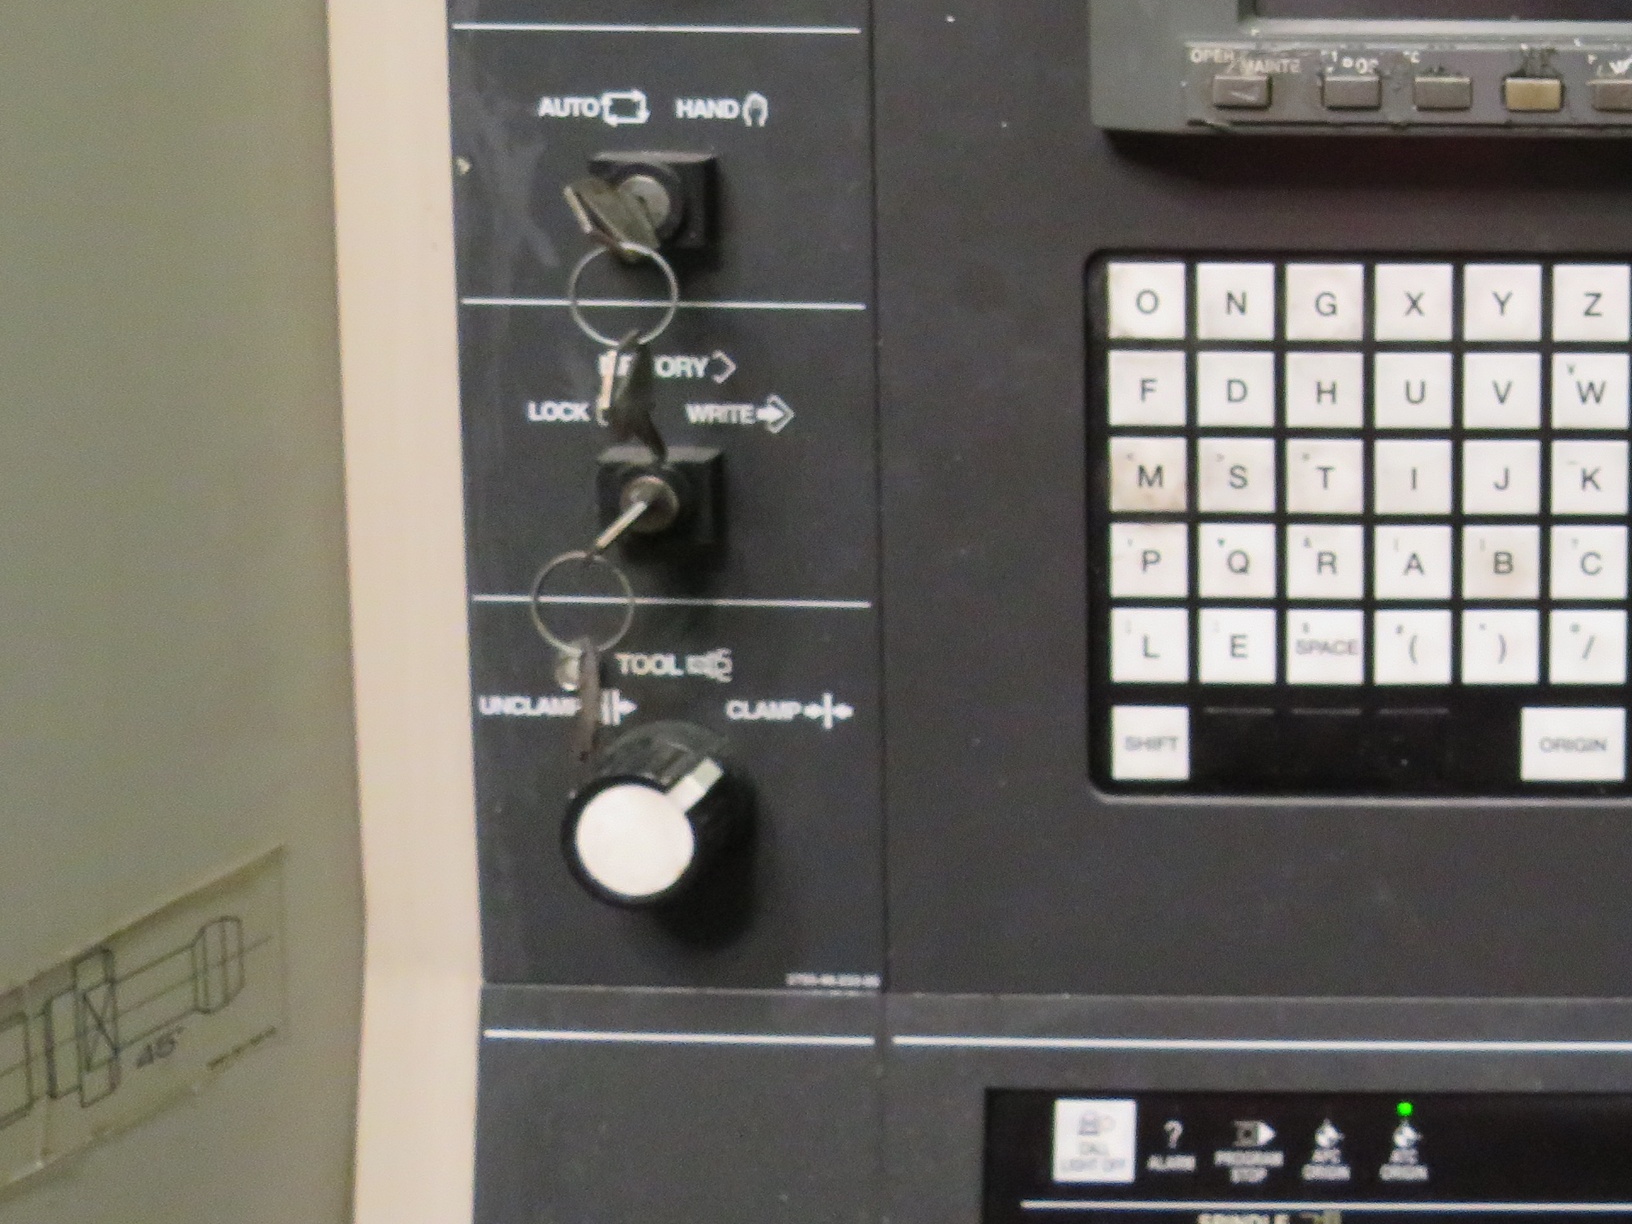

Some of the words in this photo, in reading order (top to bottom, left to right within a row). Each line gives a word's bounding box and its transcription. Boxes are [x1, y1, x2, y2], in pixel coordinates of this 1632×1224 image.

[539, 99, 599, 116] AUTO
[676, 99, 740, 118] HAND
[1136, 289, 1160, 314] O
[1226, 291, 1247, 315] N
[1315, 292, 1338, 317] G
[1405, 292, 1424, 315] X
[1493, 292, 1512, 316] Y
[1584, 292, 1602, 317] Z
[1140, 378, 1157, 402] F
[1227, 379, 1248, 403] D
[1316, 381, 1337, 403] H
[1405, 381, 1426, 405] U
[1493, 381, 1512, 405] V
[1577, 381, 1606, 404] W
[528, 401, 589, 421] LOCK
[687, 403, 755, 424] WRITE
[1138, 465, 1163, 488] M
[1229, 464, 1248, 489] S
[1316, 466, 1335, 489] T
[1494, 467, 1510, 491] J
[1582, 468, 1600, 490] K
[1141, 550, 1161, 572] P
[1227, 549, 1251, 574] Q
[1317, 551, 1337, 574] R
[1404, 552, 1424, 575] A
[1493, 551, 1514, 575] B
[1580, 551, 1602, 576] C
[1142, 635, 1160, 659] L
[1230, 634, 1247, 658] E
[1295, 640, 1359, 656] SPACE
[614, 652, 684, 675] TOOL
[728, 701, 802, 721] CLAMP
[1125, 735, 1179, 751] SHIFT
[1539, 737, 1607, 753] ORIGIN
